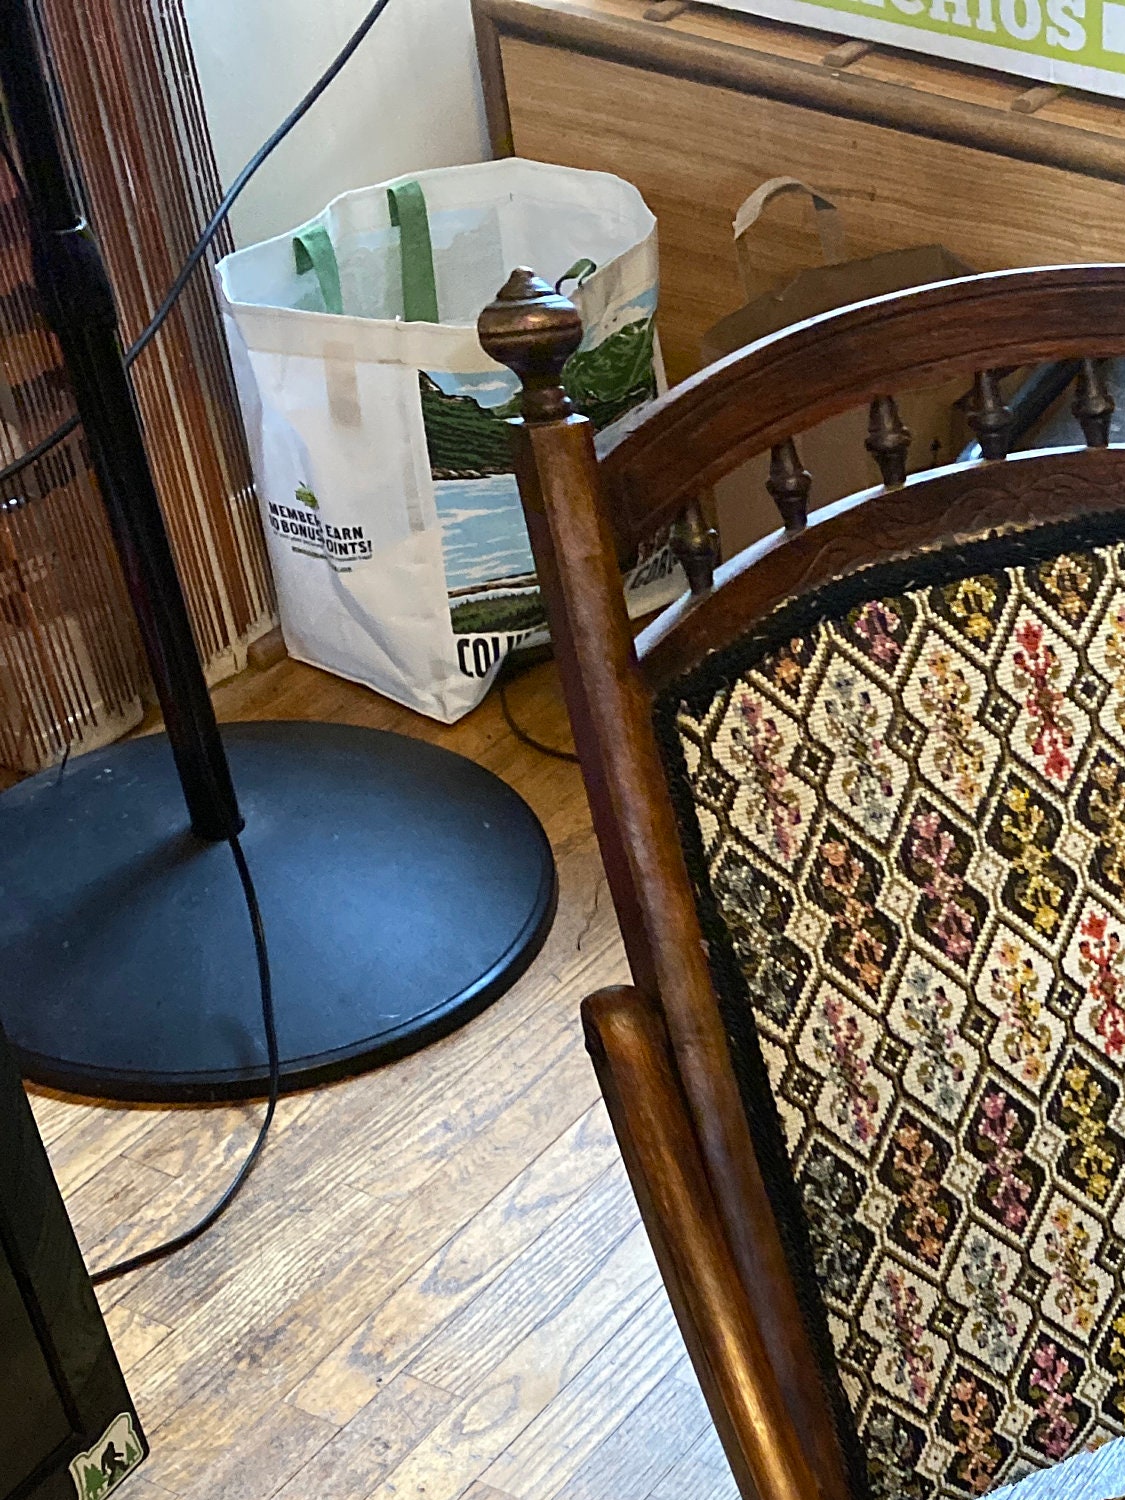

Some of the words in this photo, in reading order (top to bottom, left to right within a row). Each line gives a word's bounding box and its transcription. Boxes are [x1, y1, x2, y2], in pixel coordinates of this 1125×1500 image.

[280, 519, 325, 546] BONUS
[325, 539, 373, 556] OINTS!
[325, 524, 364, 541] EARN
